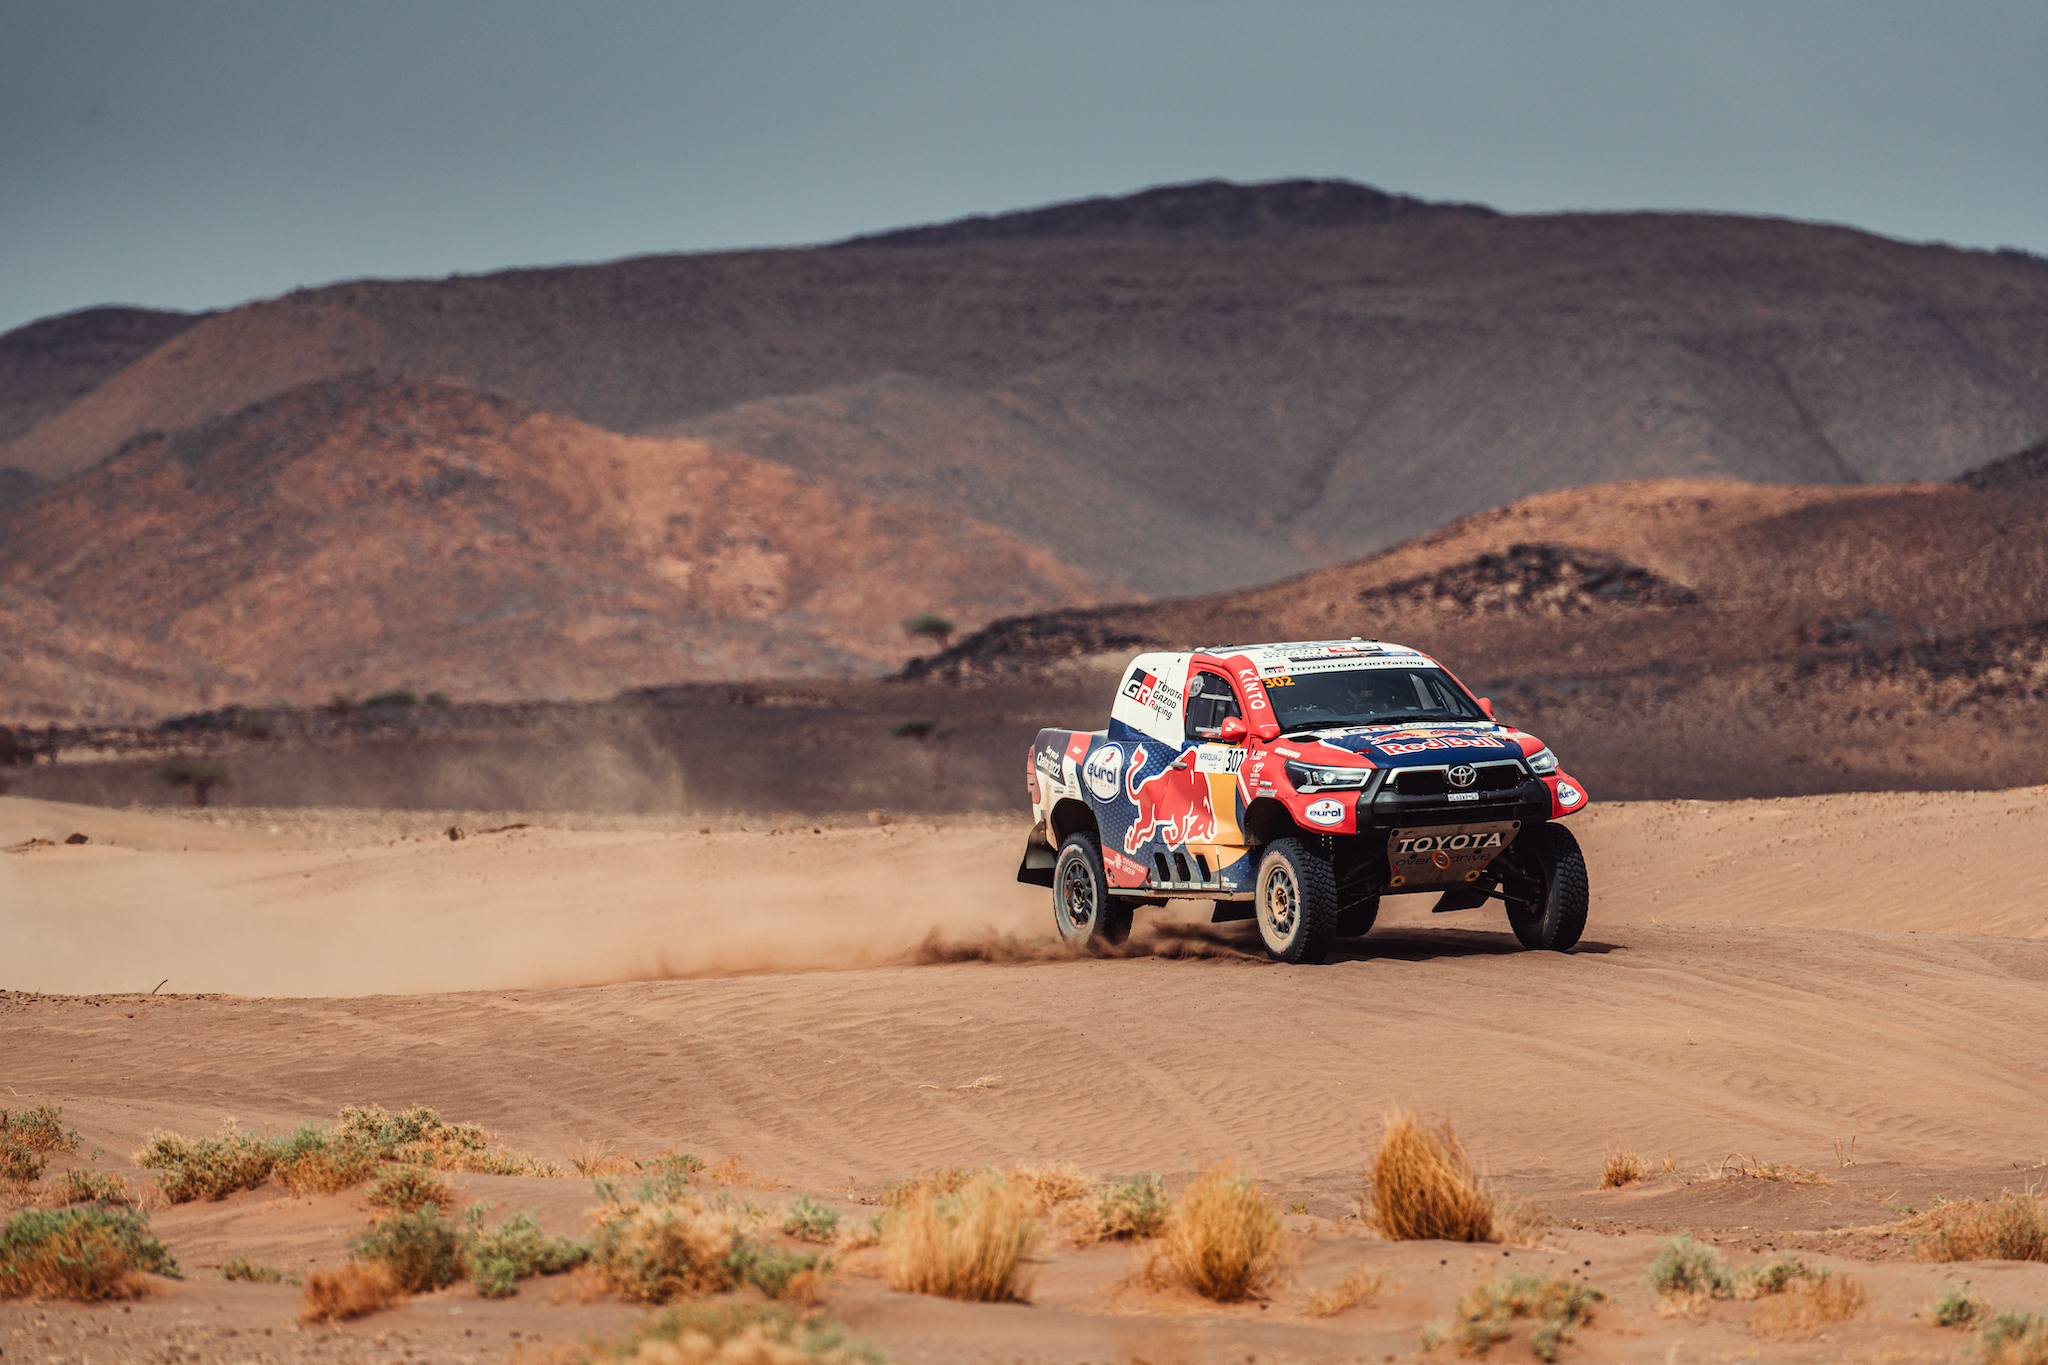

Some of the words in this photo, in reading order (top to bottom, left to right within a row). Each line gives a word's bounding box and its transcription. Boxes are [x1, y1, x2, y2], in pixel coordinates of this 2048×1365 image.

[1288, 664, 1336, 672] TOYOTA
[1337, 661, 1381, 669] GAZOO
[1382, 659, 1424, 667] Racing
[1158, 680, 1182, 701] TOYOTA
[1262, 675, 1295, 688] 302
[1153, 690, 1177, 709] GAZOO
[1148, 699, 1173, 720] Racing
[1376, 737, 1449, 756] Red
[1444, 736, 1506, 748] Bull
[1199, 752, 1218, 761] AFRIQUIA
[1087, 763, 1117, 785] eurol
[1309, 807, 1341, 817] eurol
[1399, 832, 1501, 854] TOYOTA
[1122, 857, 1146, 875] INNOVATION
[1395, 857, 1432, 867] over
[1450, 853, 1491, 863] drive
[1122, 864, 1136, 876] GROUP
